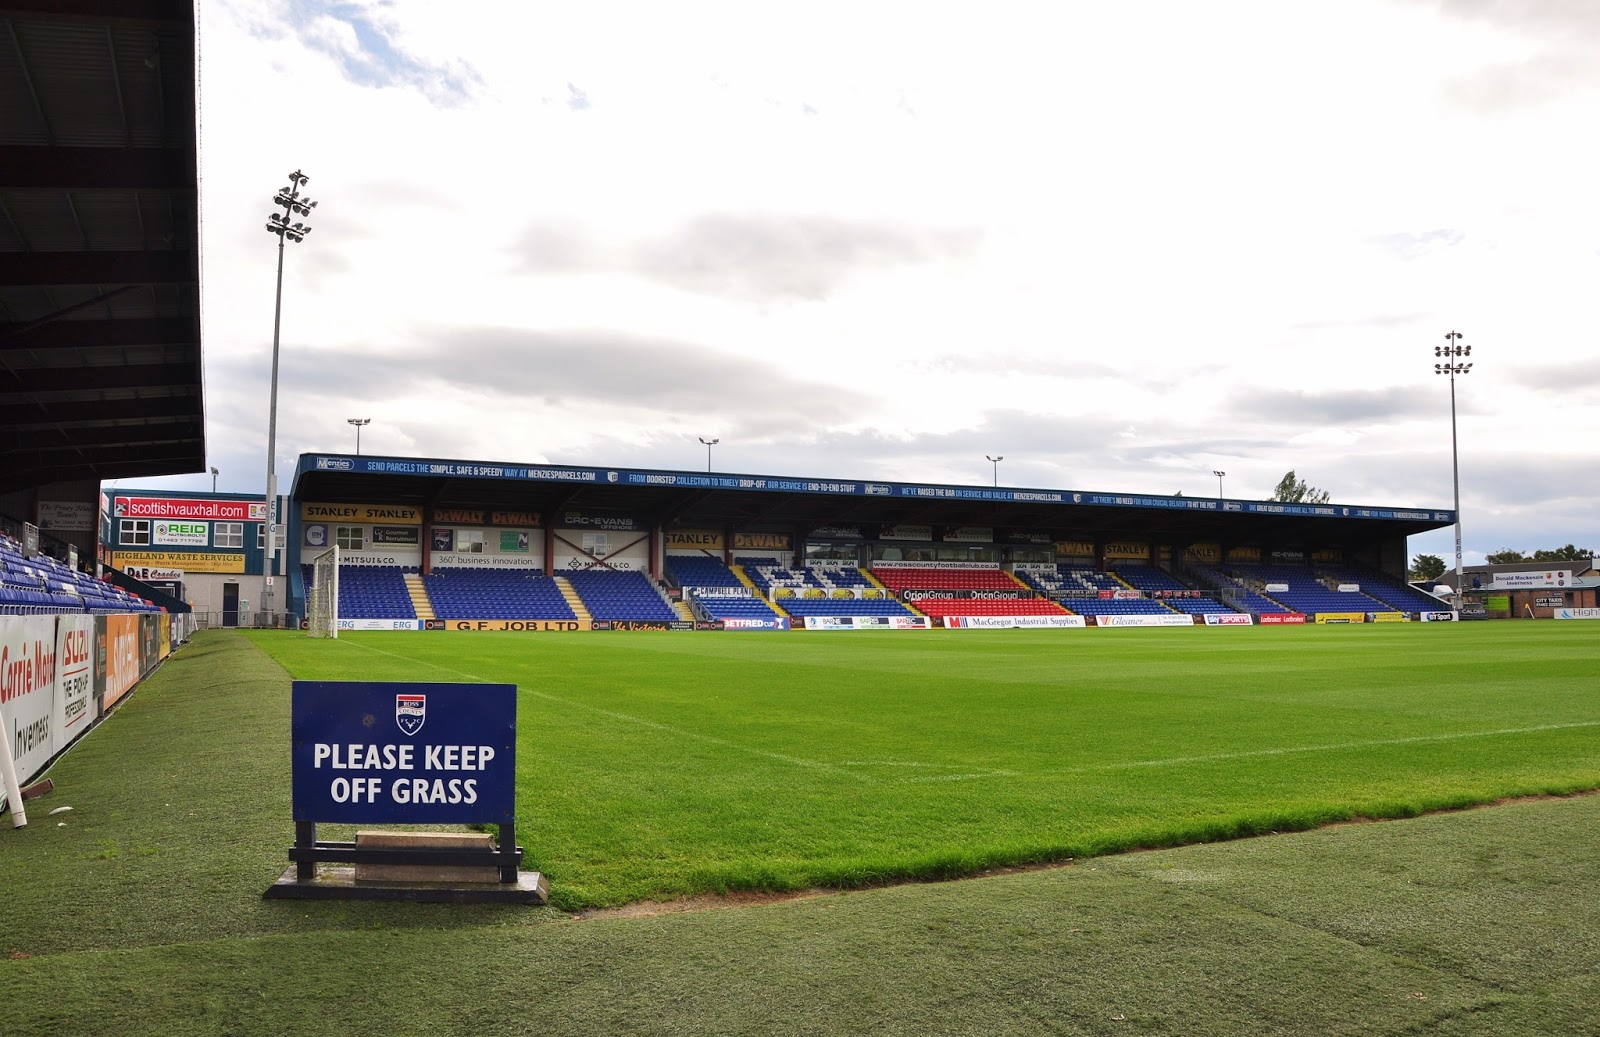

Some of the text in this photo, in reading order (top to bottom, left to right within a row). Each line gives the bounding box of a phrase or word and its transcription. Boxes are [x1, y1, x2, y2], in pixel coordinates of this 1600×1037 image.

[368, 462, 385, 470] SEND
[386, 462, 415, 472] PARCELS
[416, 464, 428, 473] THE
[430, 464, 455, 475] SIMPLE,
[456, 466, 472, 475] SAFE
[480, 467, 503, 476] SPEEDY
[504, 468, 518, 477] WAY
[519, 469, 527, 478] AT
[528, 469, 595, 481] MENZIESPARCELS.COM
[629, 474, 646, 483] FROM
[647, 475, 676, 484] DOORSTEP
[677, 476, 710, 486] COLLECTION
[711, 478, 718, 486] TO
[719, 478, 738, 487] TIMELY
[768, 480, 778, 489] OUR
[780, 481, 801, 490] SERVICE
[808, 483, 839, 492] END-TO-END
[840, 484, 855, 492] STUFF
[902, 487, 917, 496] WE'VE
[918, 488, 934, 496] RAISED
[963, 490, 982, 498] SERVICE
[132, 502, 243, 517] scottishvauxhall.com
[308, 507, 416, 518] STANLEY STANLEY
[565, 517, 632, 525] CRC-EVANS
[169, 524, 205, 533] REID
[666, 534, 718, 544] STANLEY
[1106, 545, 1145, 554] STANLEY
[114, 552, 164, 560] HIGHLAND
[458, 556, 490, 564] business
[128, 568, 149, 579] D&E
[612, 621, 626, 631] The
[629, 621, 667, 631] Victoria
[972, 617, 1012, 627] MacGregor
[1050, 617, 1078, 626] Supplies
[1112, 616, 1142, 625] Gleaner
[500, 622, 538, 631] JOB
[544, 622, 579, 631] LTD
[62, 630, 89, 666] ISUZU
[0, 642, 32, 704] Corrie
[63, 680, 72, 698] THE
[14, 714, 49, 761] Inverness
[314, 744, 495, 771] PLEASE KEEP
[331, 777, 477, 804] OFF GRASS
